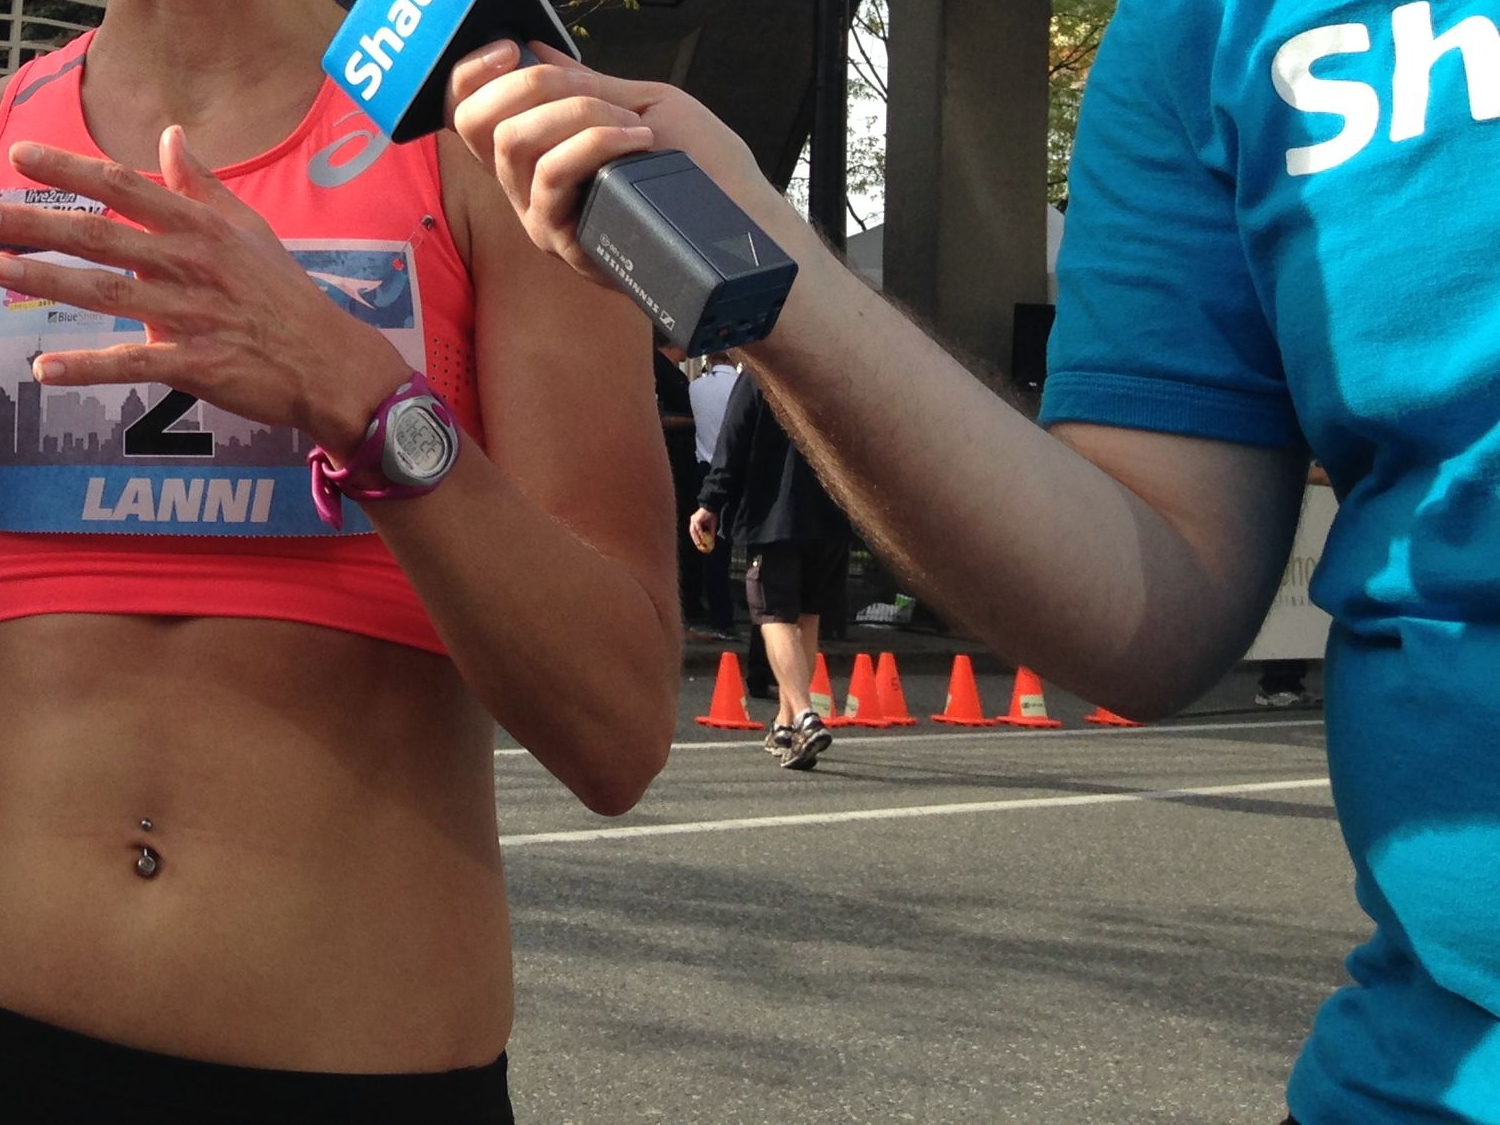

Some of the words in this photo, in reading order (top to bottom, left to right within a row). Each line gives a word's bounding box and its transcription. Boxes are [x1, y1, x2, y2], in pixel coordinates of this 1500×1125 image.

[26, 190, 76, 203] live2run
[596, 244, 660, 313] SENNHEISER
[82, 477, 275, 523] LANNI
